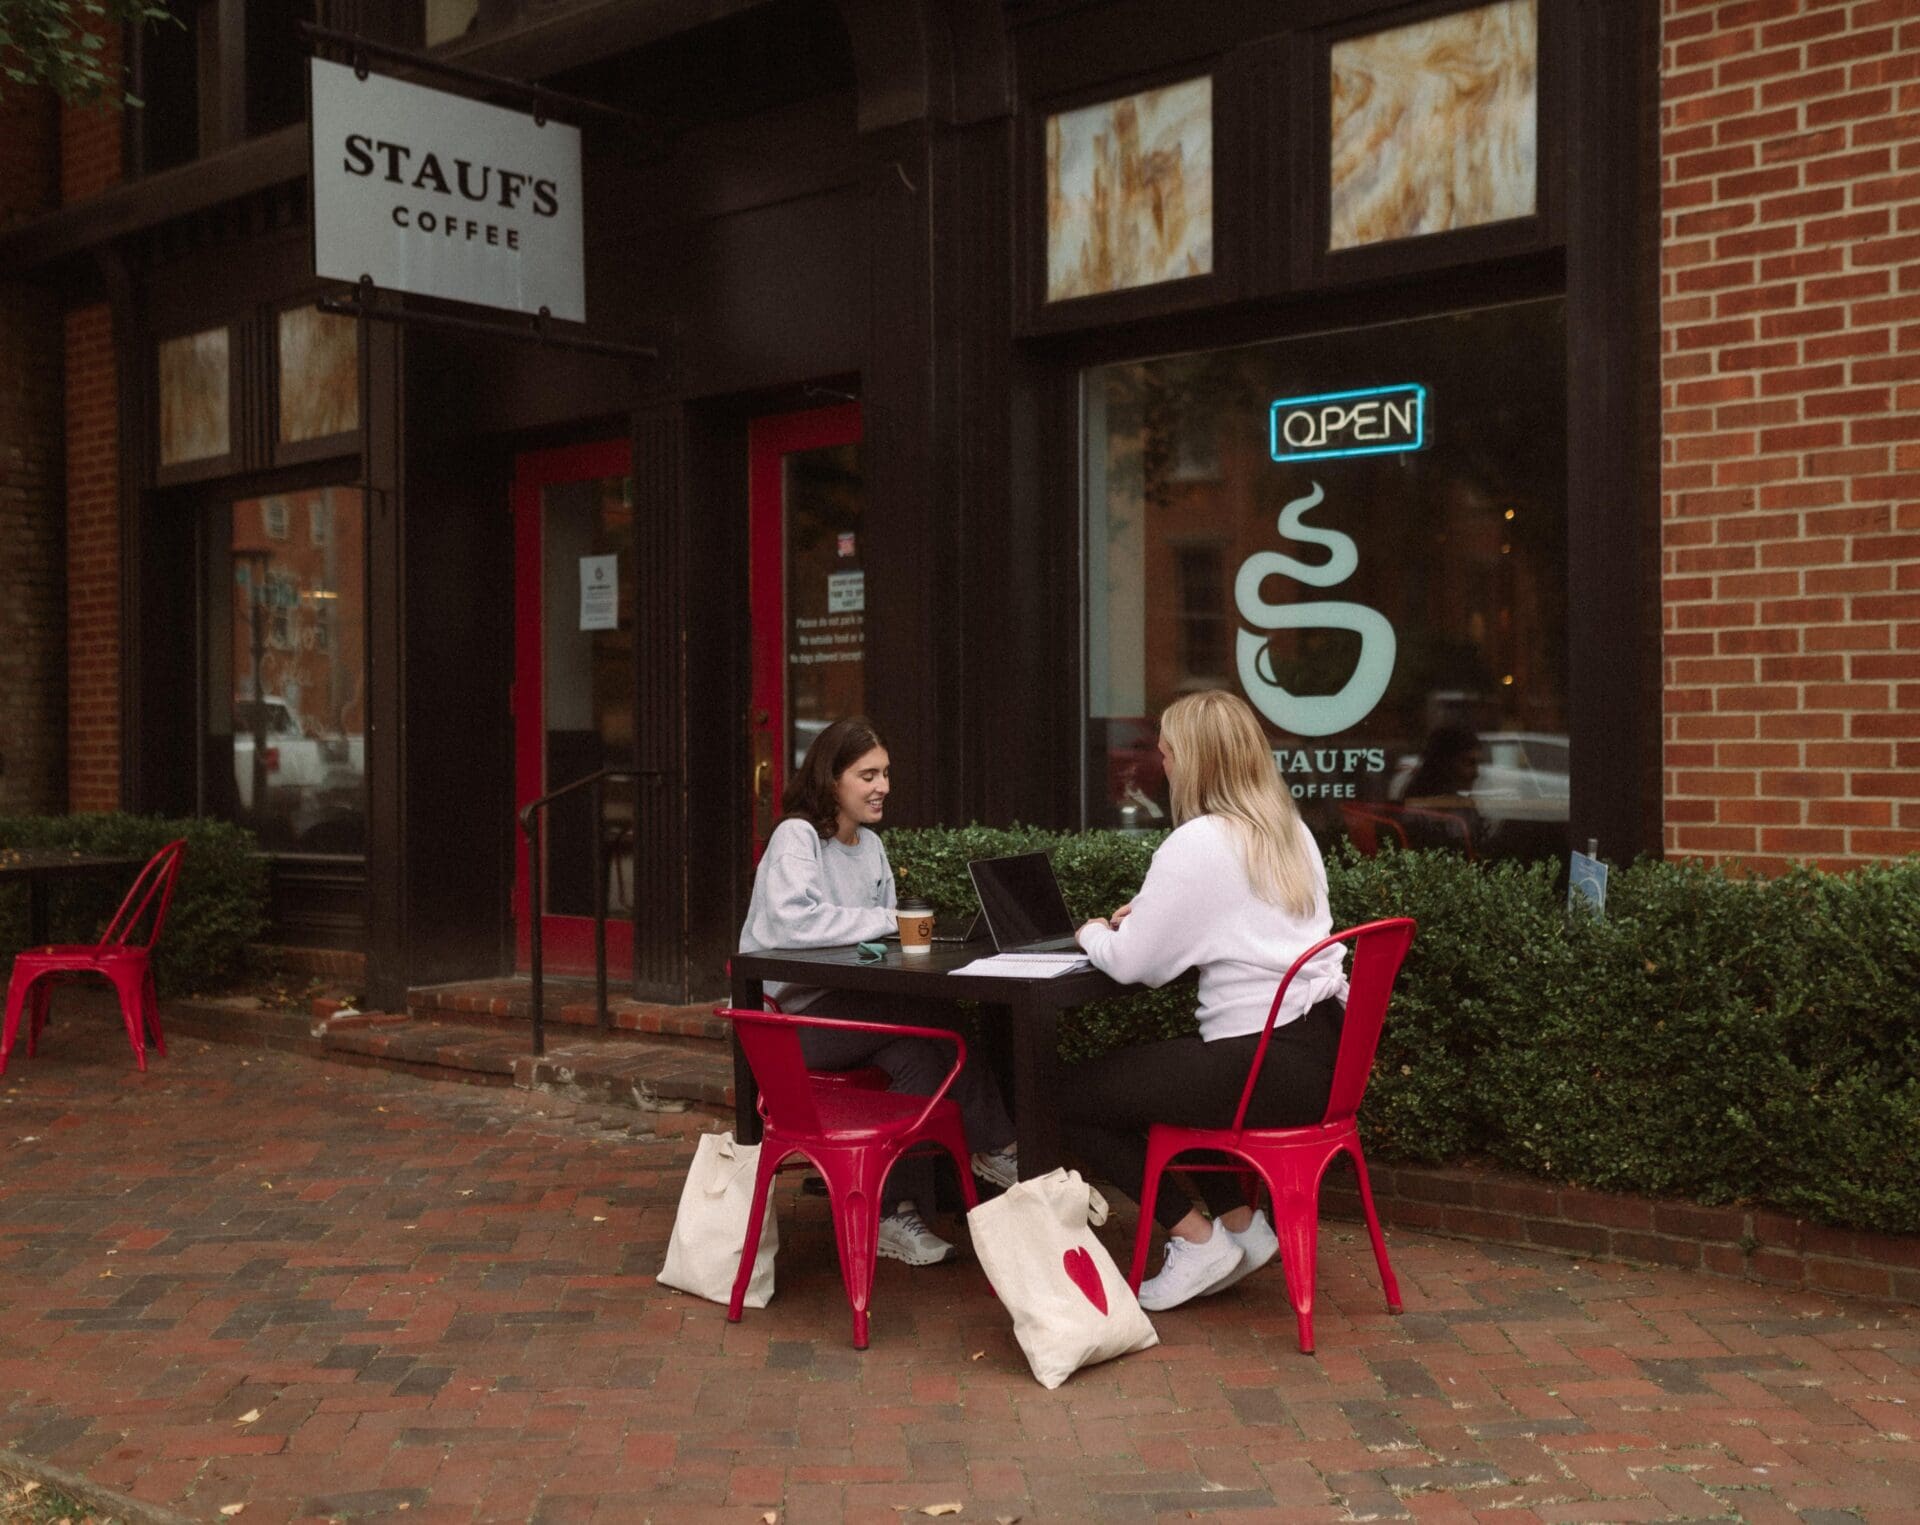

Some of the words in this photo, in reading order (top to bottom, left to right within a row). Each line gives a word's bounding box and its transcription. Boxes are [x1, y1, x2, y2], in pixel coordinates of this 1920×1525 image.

[344, 133, 558, 218] STAUF'S
[392, 206, 520, 250] COFFEE
[1283, 401, 1416, 447] OPEN
[1272, 748, 1386, 773] TAUF'S
[1291, 784, 1356, 798] OFFEE
